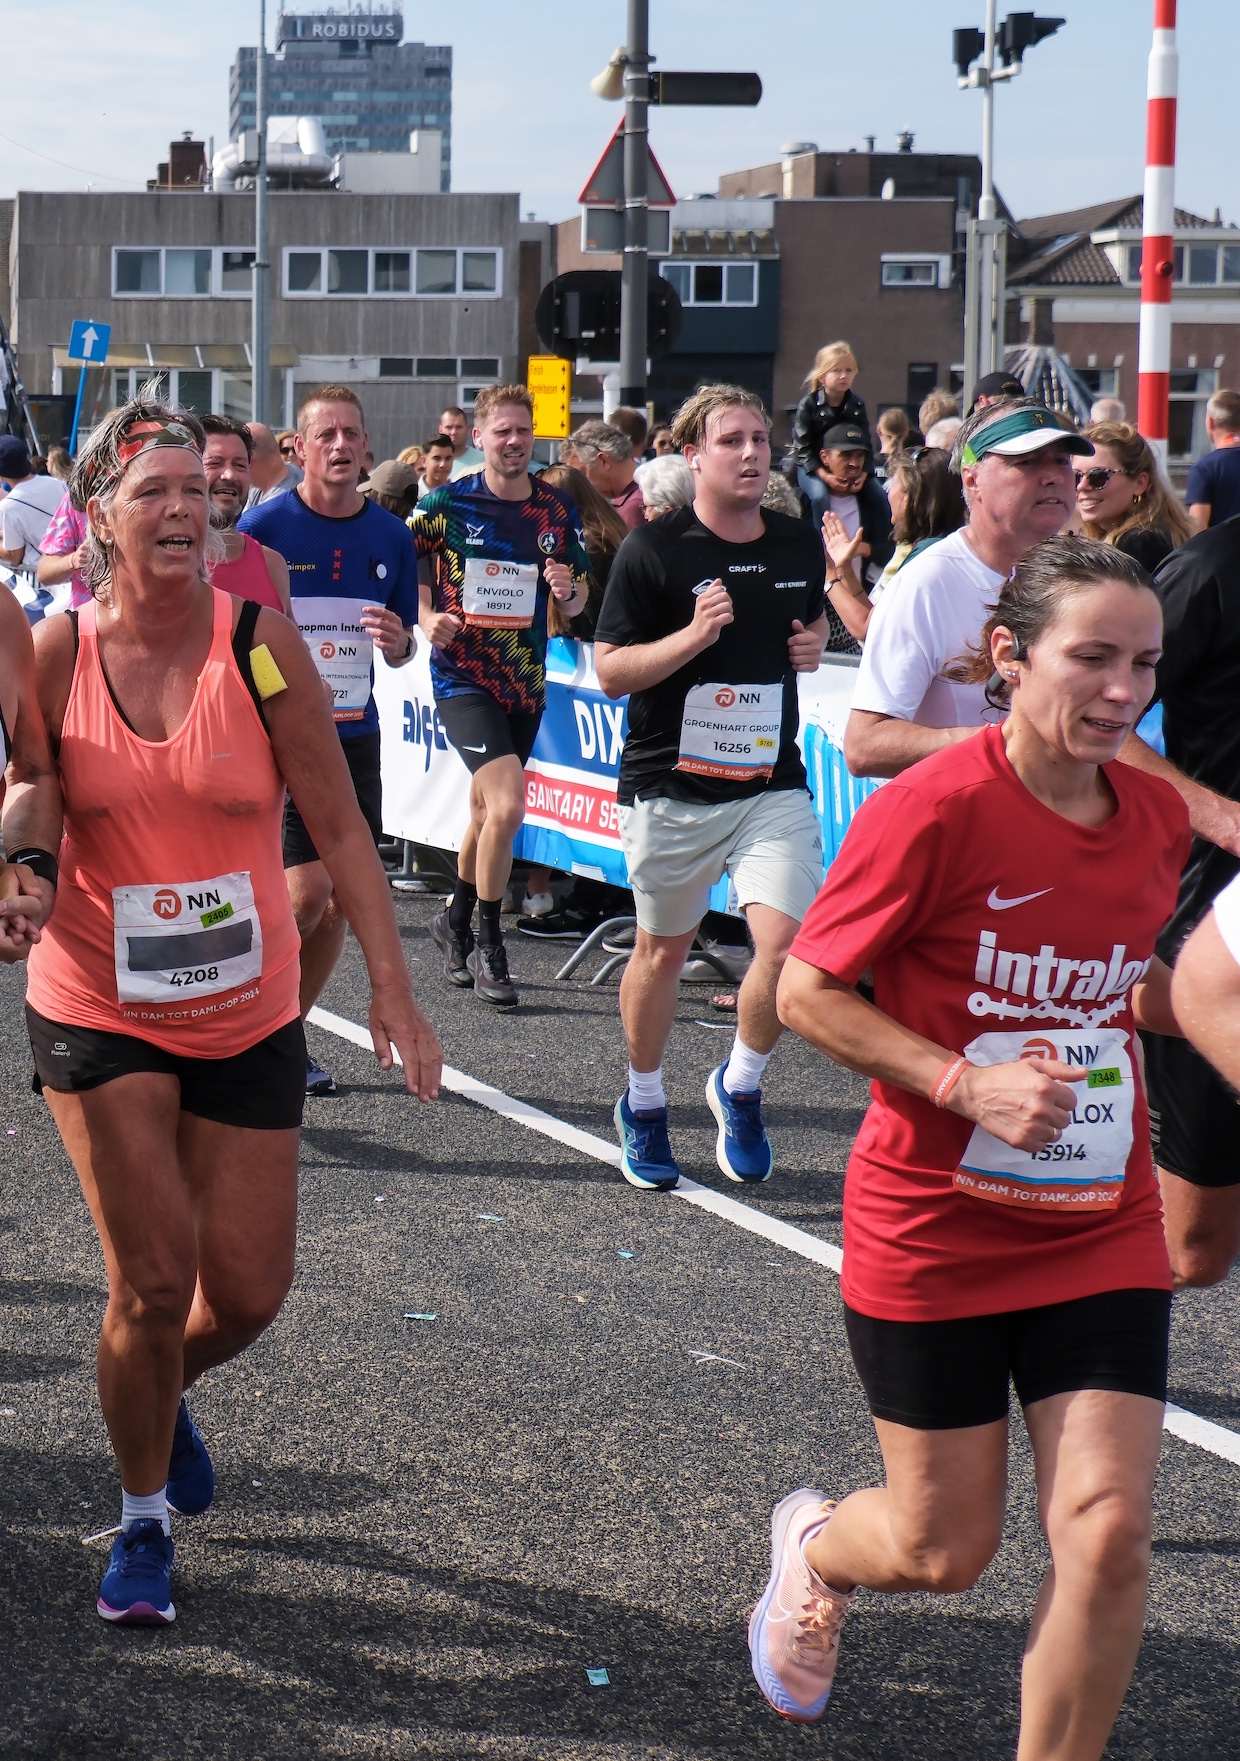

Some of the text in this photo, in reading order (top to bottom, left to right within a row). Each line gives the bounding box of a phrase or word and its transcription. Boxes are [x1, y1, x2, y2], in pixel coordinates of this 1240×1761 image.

[312, 23, 396, 38] ROBIDUS
[502, 567, 520, 576] NN
[728, 565, 758, 573] CRAFT
[477, 587, 524, 597] ENVIOLO
[486, 602, 512, 610] 18912
[338, 646, 357, 657] NN
[739, 693, 761, 704] NN
[684, 718, 746, 732] GROENHART
[713, 741, 751, 754] 16256
[691, 763, 708, 771] DAM
[709, 766, 723, 774] TOT
[187, 889, 221, 911] NN
[207, 908, 229, 924] 2405
[170, 967, 219, 987] 4208
[123, 1011, 138, 1019] NN
[141, 1012, 165, 1020] DAM
[167, 1011, 188, 1019] TOT
[191, 997, 239, 1017] DAMLOOP
[1065, 1045, 1099, 1066] NN
[1092, 1072, 1115, 1084] 7348
[1069, 1103, 1115, 1125] LOX
[955, 1174, 975, 1187] NN
[978, 1180, 1009, 1196] DAM
[1012, 1188, 1038, 1201] TOT
[1039, 1192, 1095, 1203] DAMLOOP
